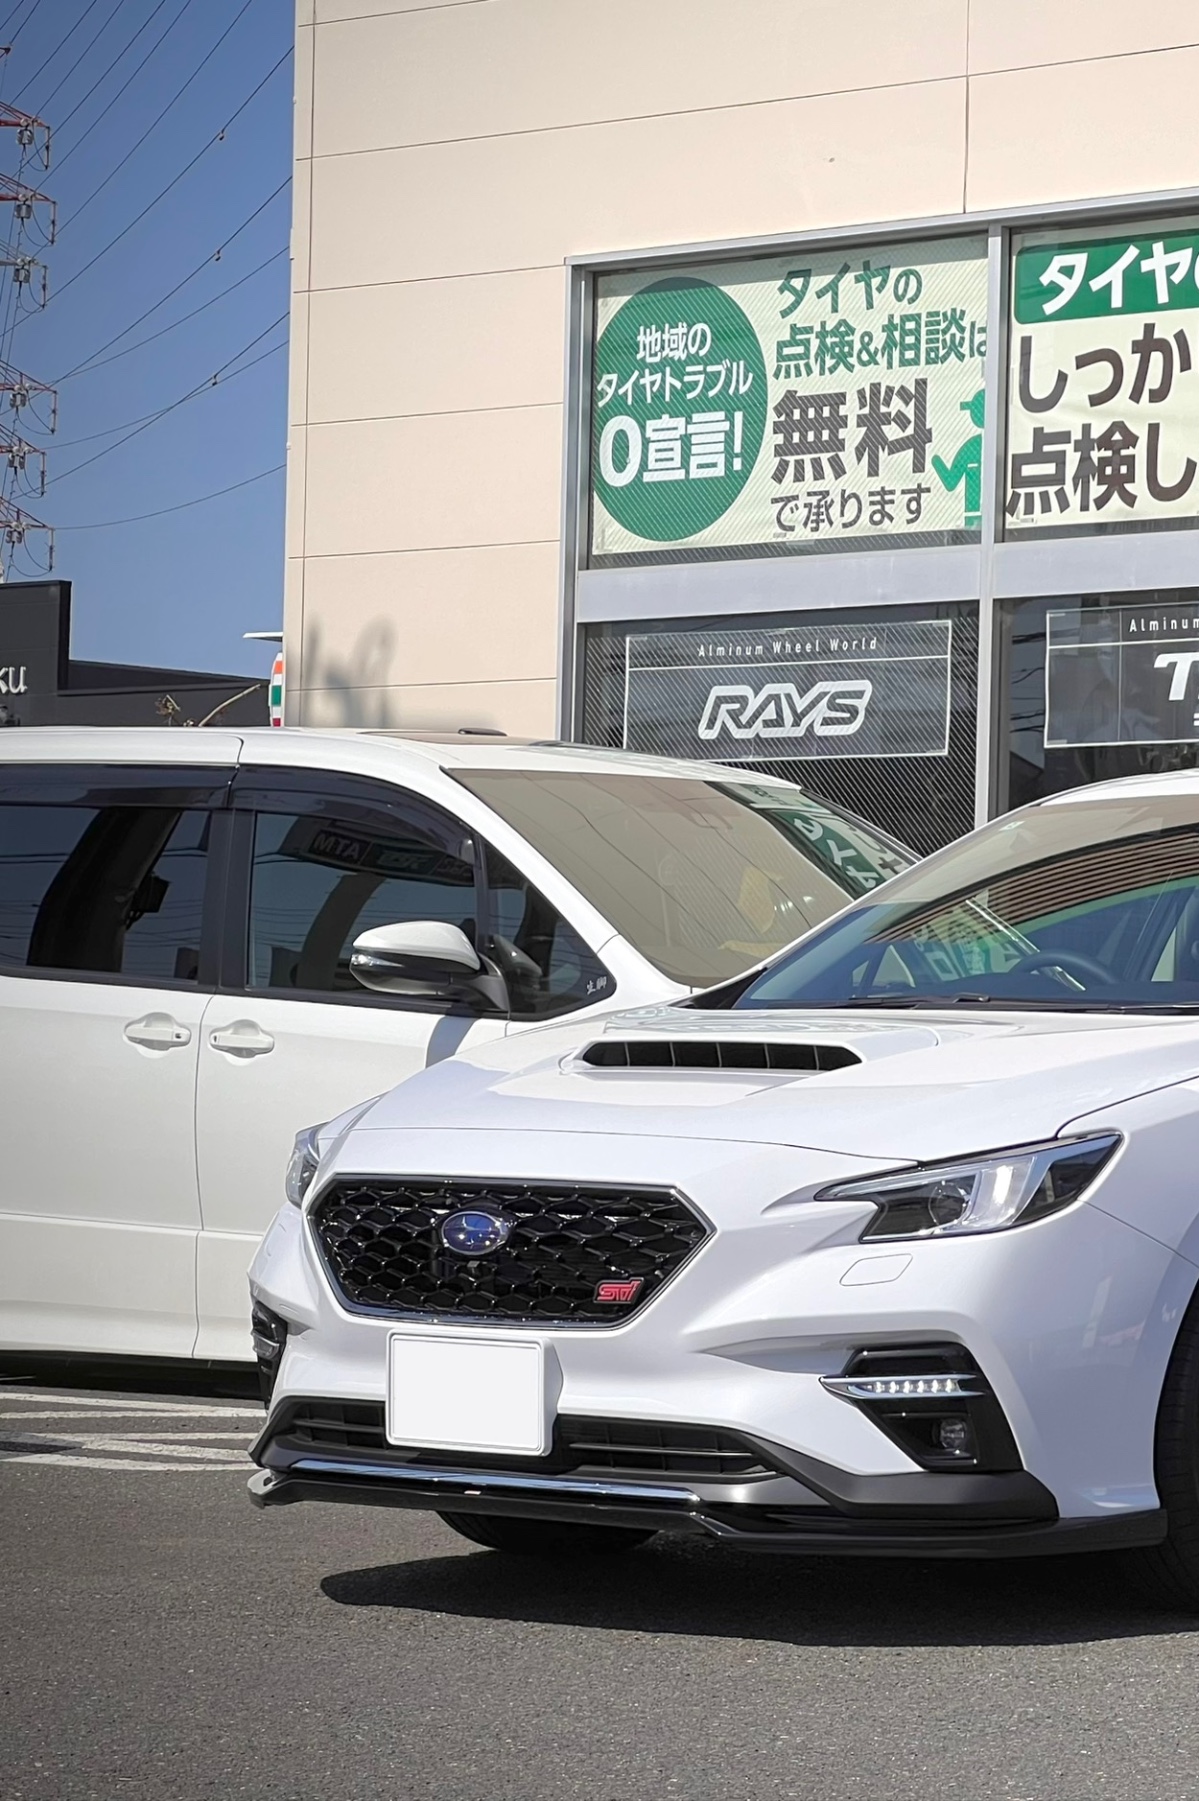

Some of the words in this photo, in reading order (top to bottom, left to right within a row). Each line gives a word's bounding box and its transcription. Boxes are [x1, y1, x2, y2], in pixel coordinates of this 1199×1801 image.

[776, 260, 923, 319] タイヤの
[635, 322, 712, 364] 地域の
[597, 360, 753, 408] タイヤトラブル
[770, 378, 933, 485] 無料
[770, 482, 932, 533] で承ります
[697, 642, 763, 657] Alminum
[773, 639, 820, 654] Wheel
[830, 636, 877, 651] World
[698, 680, 873, 740] RAYS
